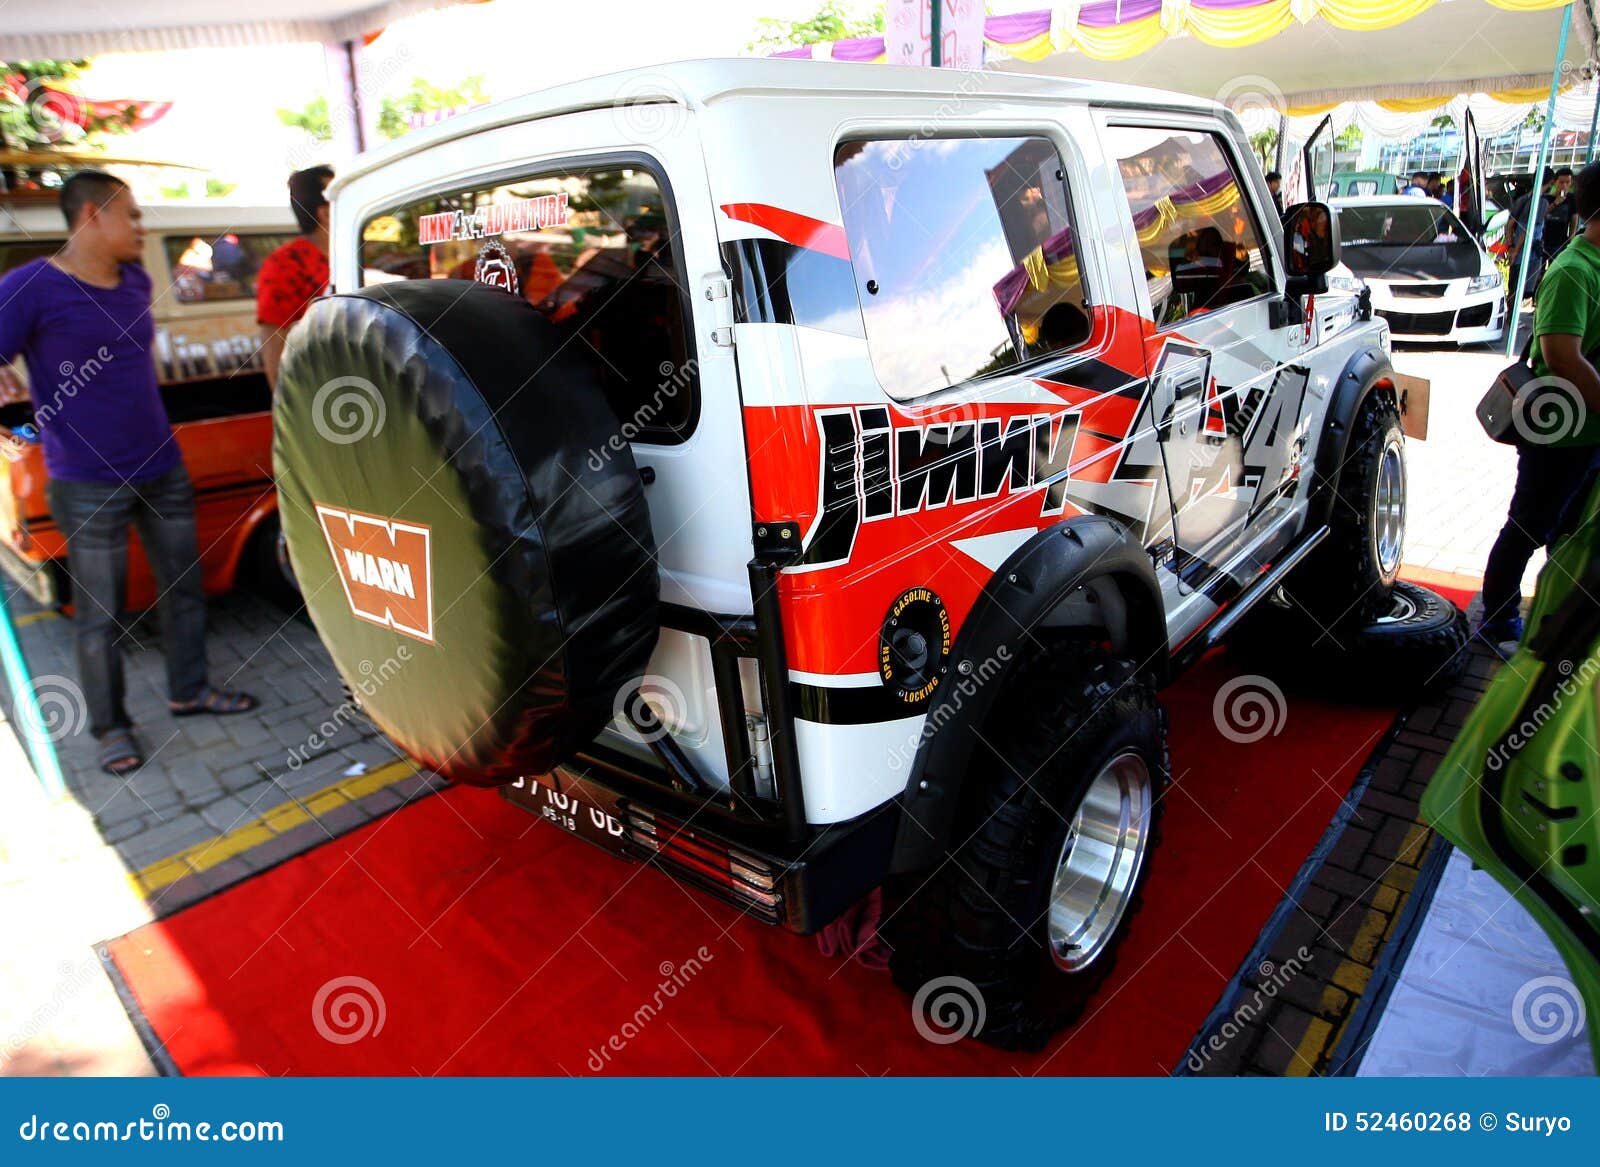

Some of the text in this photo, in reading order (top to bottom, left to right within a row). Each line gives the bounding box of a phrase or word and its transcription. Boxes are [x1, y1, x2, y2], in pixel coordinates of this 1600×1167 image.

[343, 547, 416, 600] WARN
[893, 589, 932, 617] GASOLINE
[939, 609, 950, 655] CLOSED
[882, 646, 893, 680] OPEN
[903, 676, 940, 703] LOCKING
